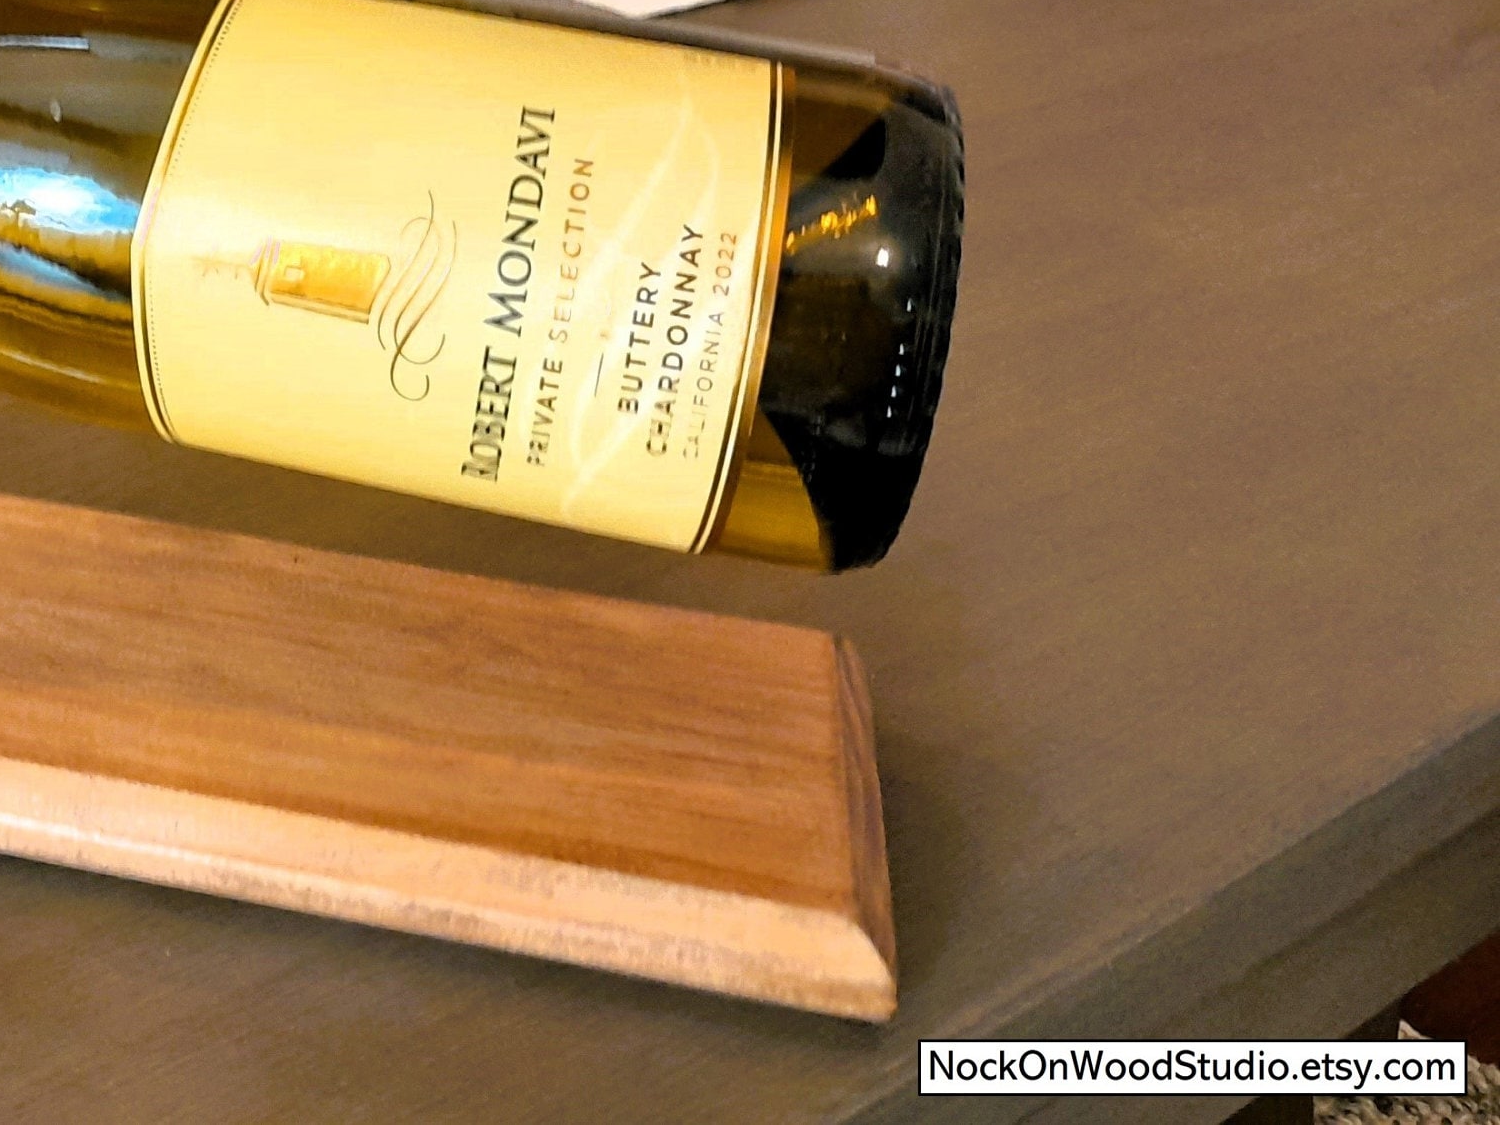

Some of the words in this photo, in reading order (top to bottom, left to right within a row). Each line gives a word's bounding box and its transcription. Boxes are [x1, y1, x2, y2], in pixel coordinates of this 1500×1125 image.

[483, 104, 556, 338] MONDAVI
[527, 358, 563, 467] PRIVATE
[548, 158, 595, 344] SELECTION
[713, 232, 738, 297] 2022
[460, 345, 517, 482] ROBERT
[617, 262, 662, 415] BUTTERY
[646, 224, 703, 457] CHARDONNAY
